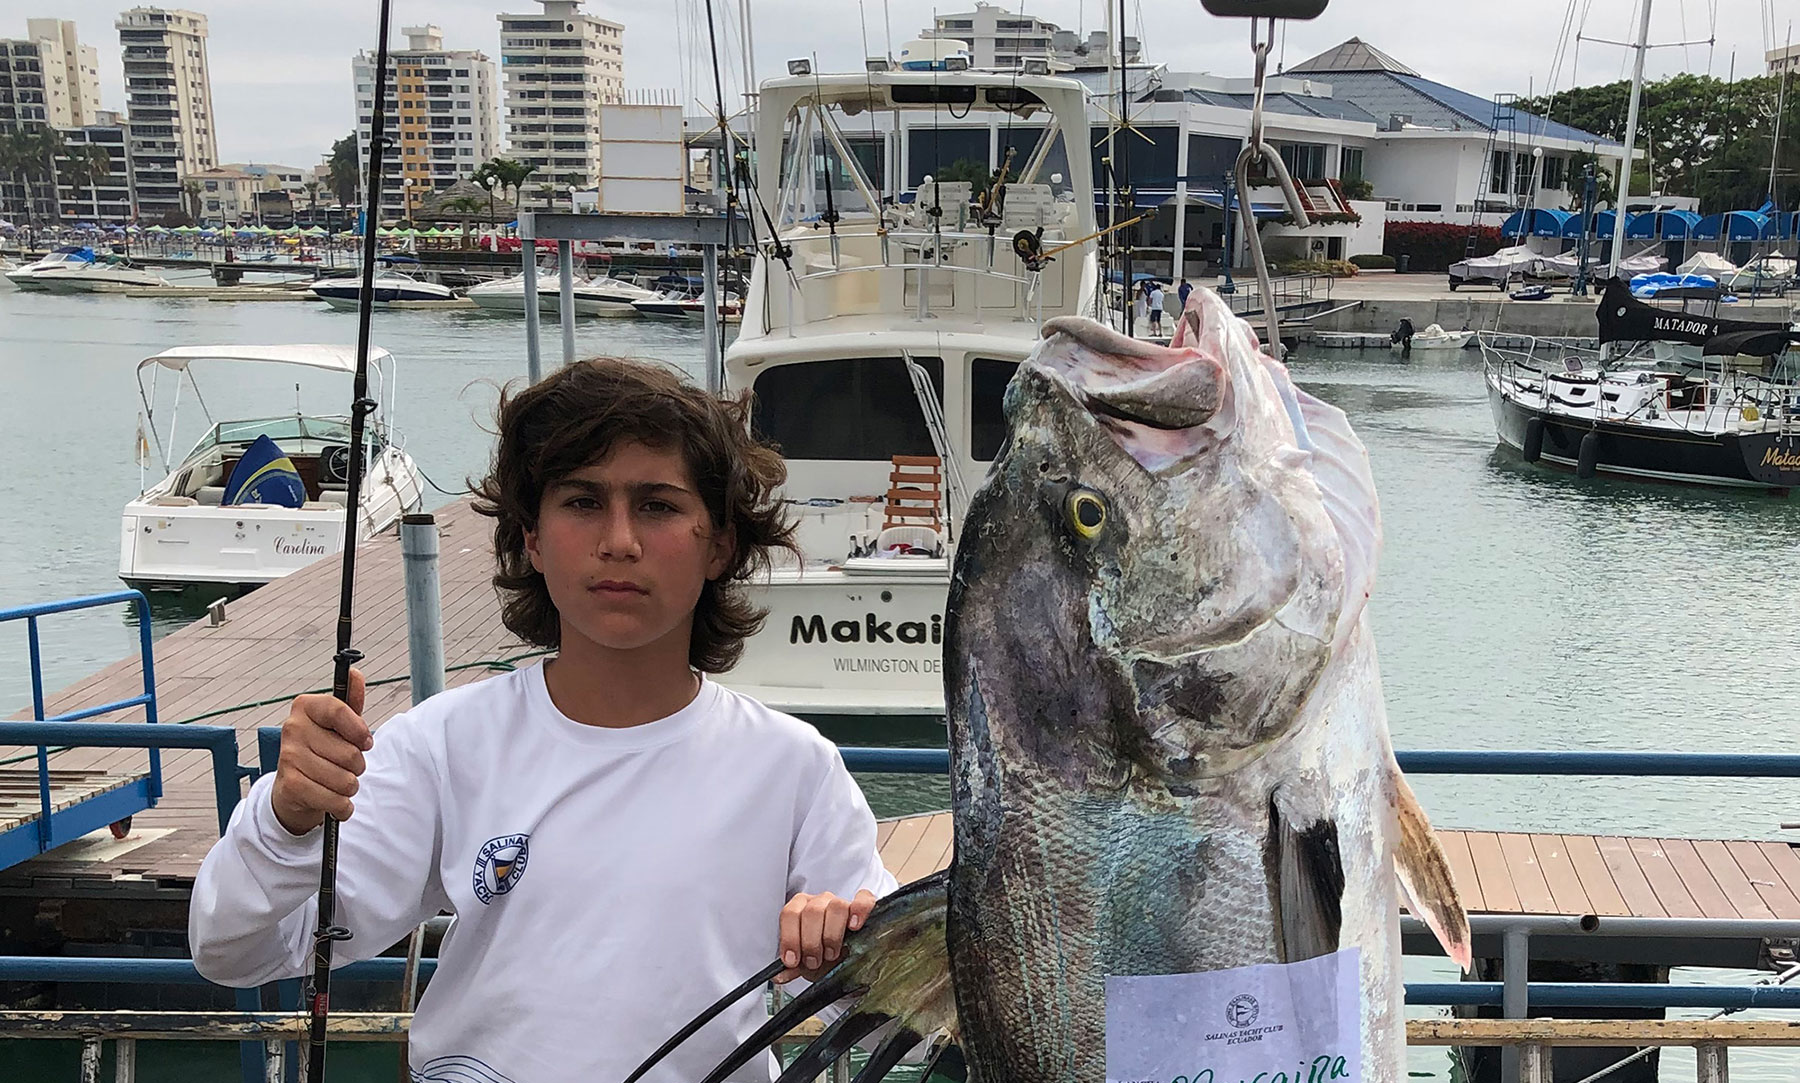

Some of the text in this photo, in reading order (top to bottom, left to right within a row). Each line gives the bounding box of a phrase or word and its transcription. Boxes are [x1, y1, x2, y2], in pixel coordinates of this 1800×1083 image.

[1654, 317, 1719, 336] MATADOR 4
[273, 536, 325, 555] Carolina
[790, 612, 942, 645] Makai
[834, 658, 941, 674] WILMINGTON DE
[482, 836, 525, 858] SALINA
[511, 846, 527, 880] CLUB
[474, 870, 494, 902] YACH
[1204, 1024, 1284, 1041] SALINAS YACHT CLUB
[1227, 1034, 1263, 1045] ECUADOR
